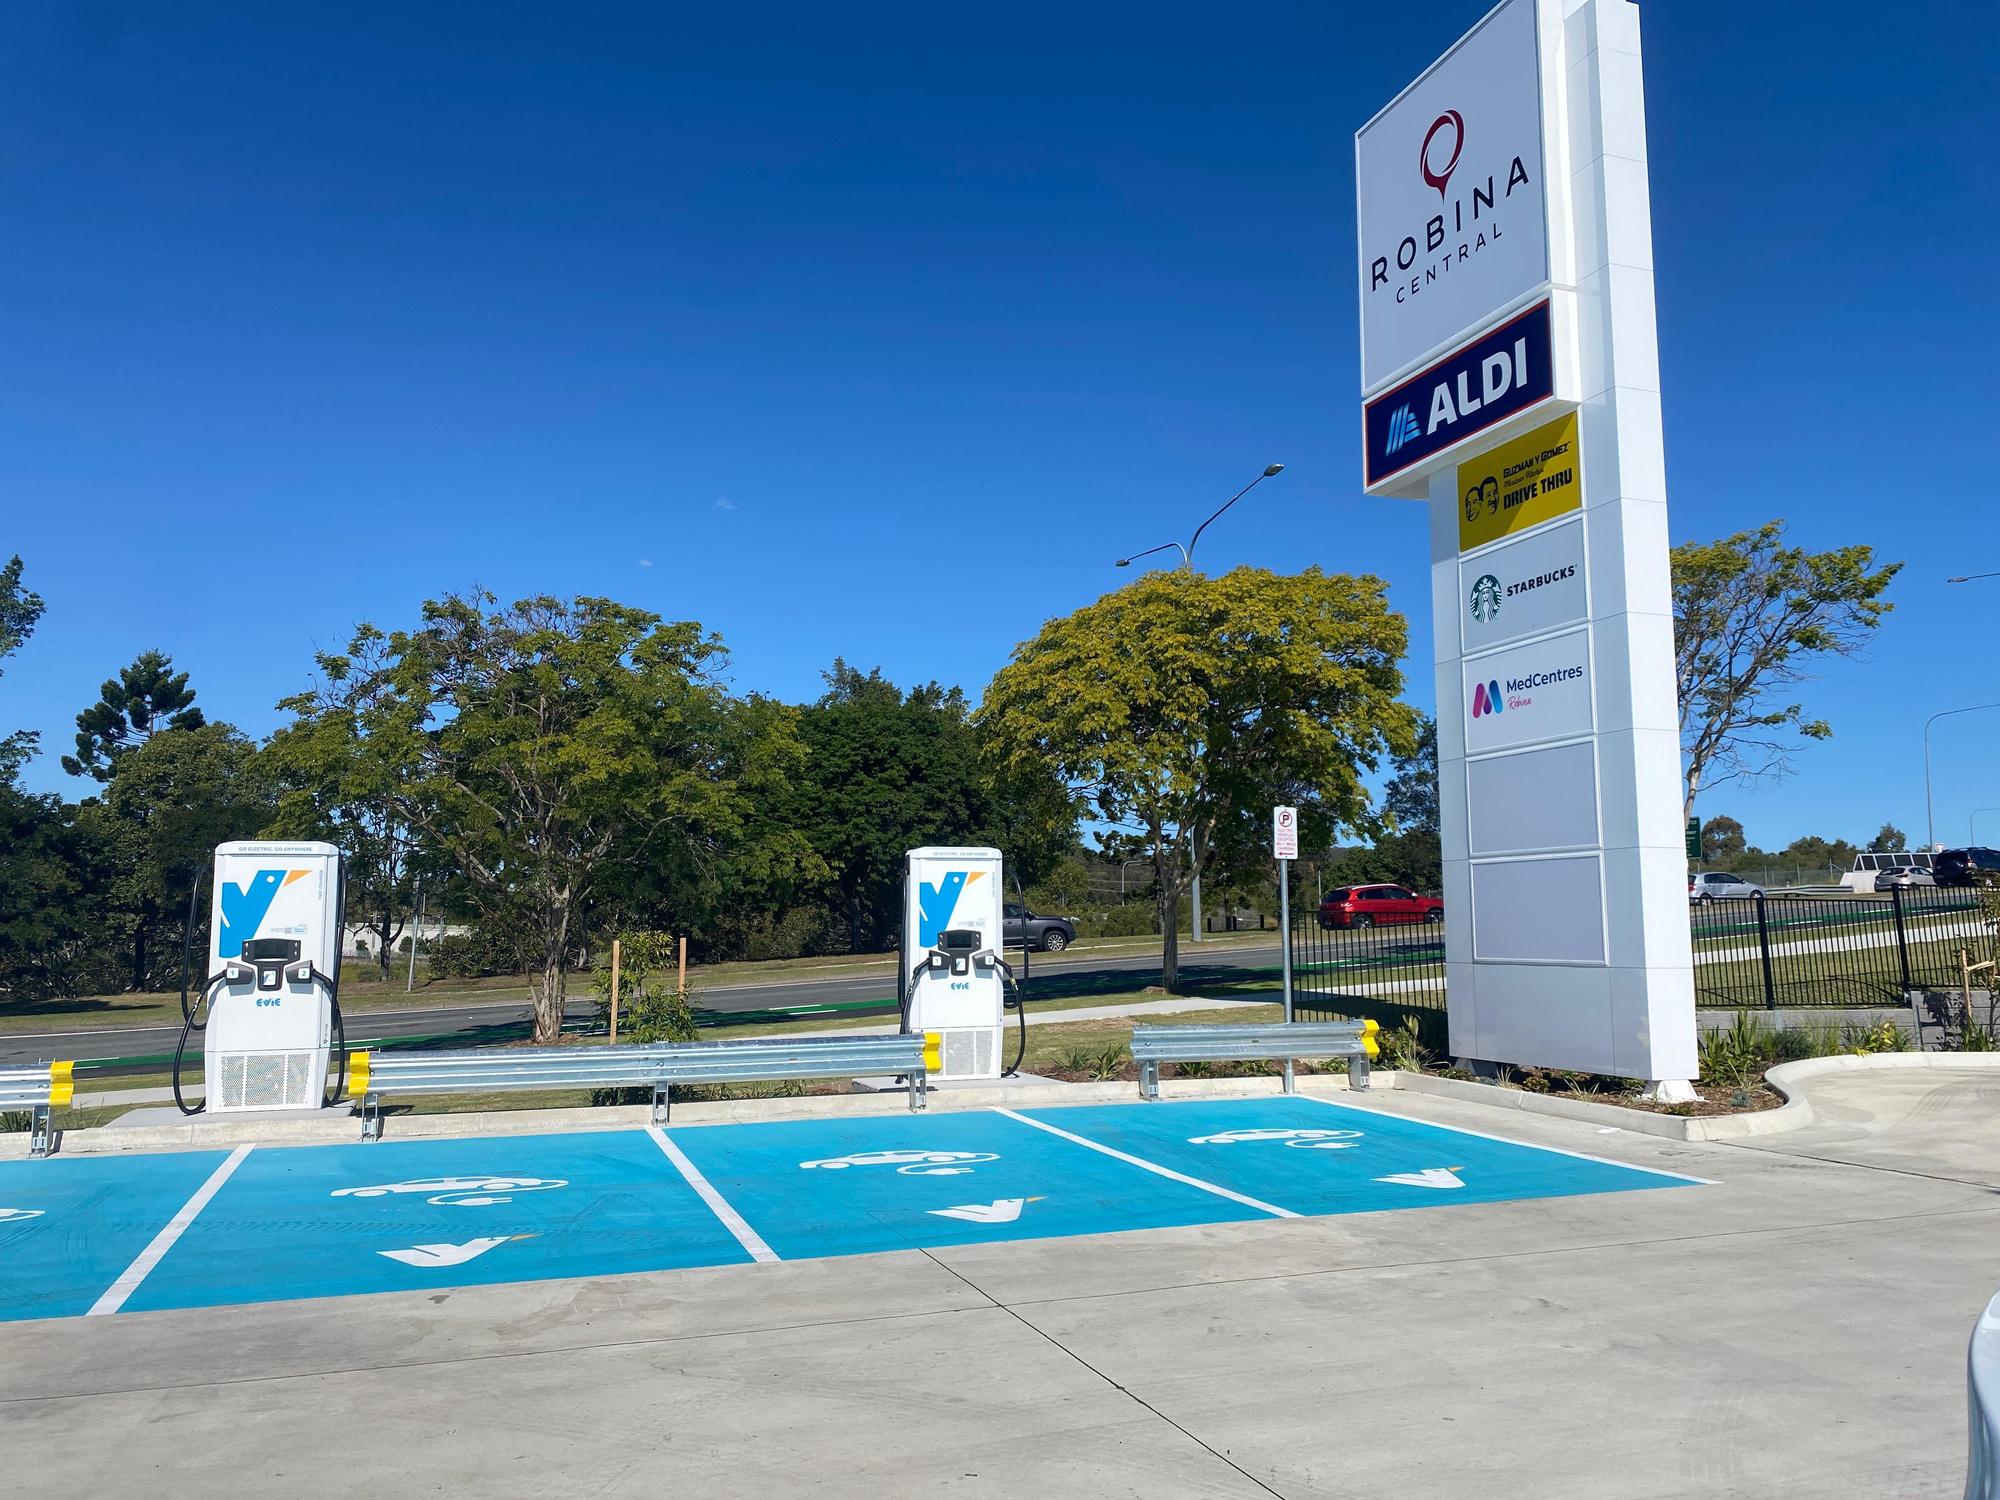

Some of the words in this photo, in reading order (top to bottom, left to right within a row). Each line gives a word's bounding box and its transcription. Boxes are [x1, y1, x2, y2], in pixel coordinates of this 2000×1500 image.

[1372, 156, 1529, 292] ROBINA
[1397, 223, 1502, 303] CENTRAL
[1427, 337, 1527, 435] ALDI
[1503, 457, 1533, 478] GUZMAN
[1535, 455, 1540, 464] Y
[1541, 443, 1568, 461] GOMEZ
[1504, 482, 1538, 509] DRIVE
[1541, 468, 1572, 494] THRU
[1507, 565, 1575, 596] STARBUCKS
[1507, 666, 1583, 693] MedCentres
